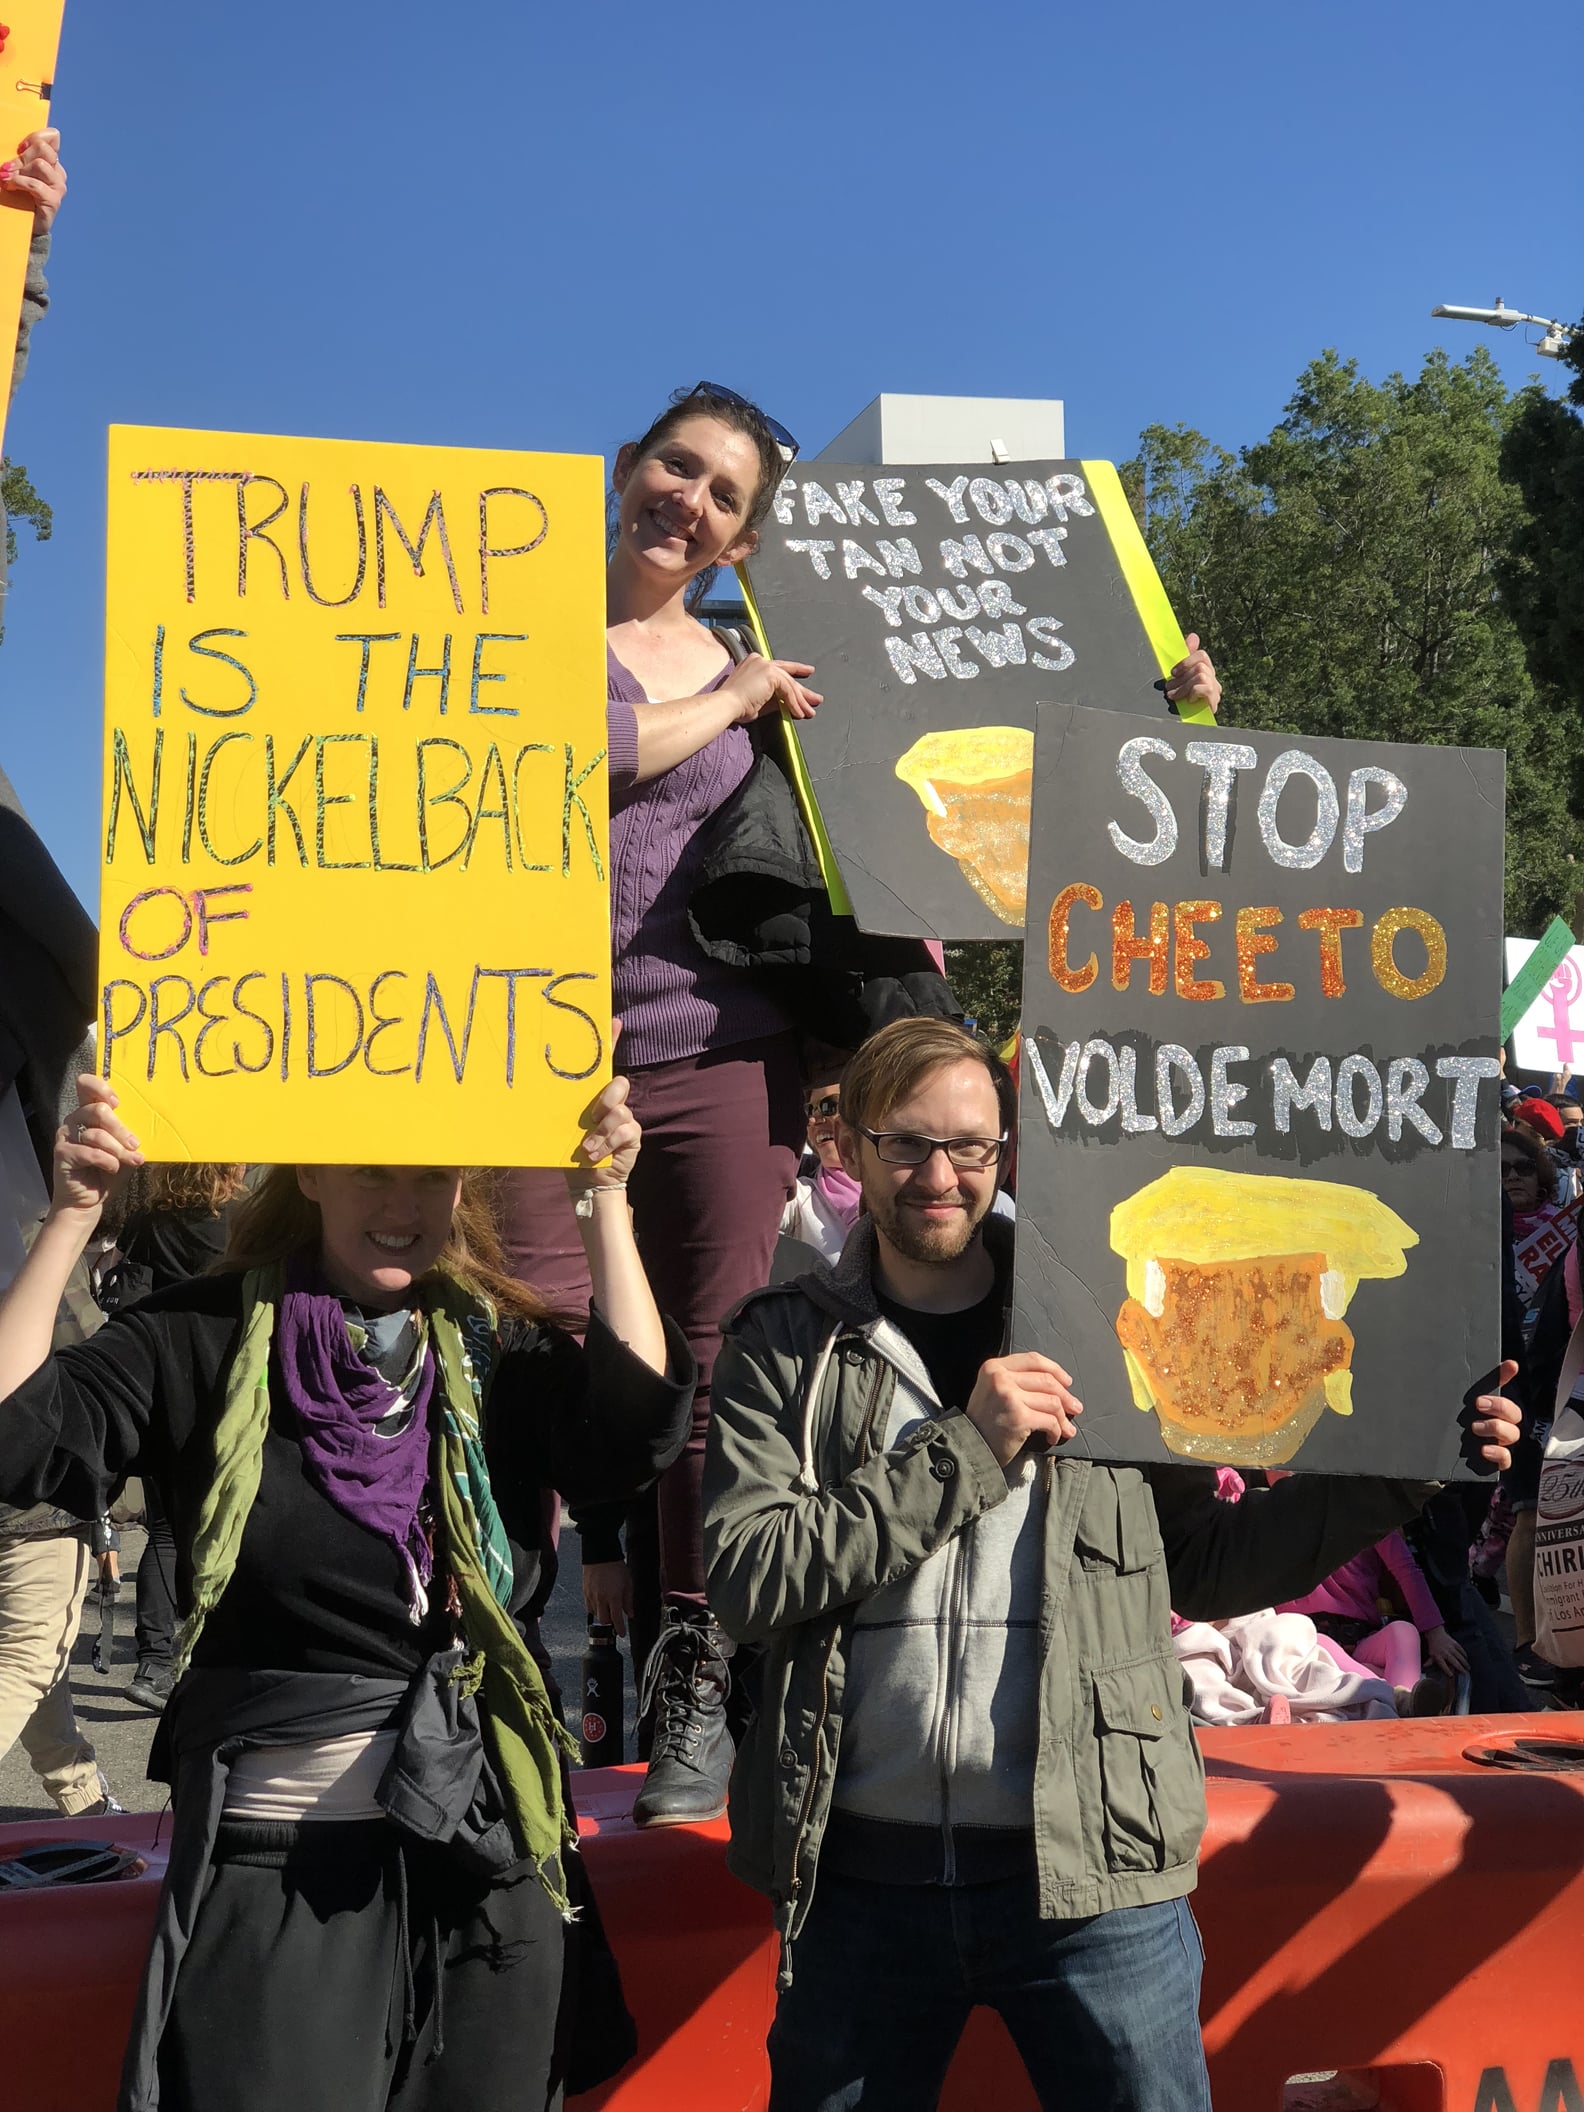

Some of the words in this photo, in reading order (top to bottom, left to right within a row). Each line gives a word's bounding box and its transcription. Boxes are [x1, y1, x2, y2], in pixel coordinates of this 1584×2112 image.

[130, 467, 548, 615] TRUMP
[772, 477, 918, 527] FAKE
[925, 473, 1096, 526] YOUR
[785, 537, 924, 580] TAN
[939, 526, 1068, 578] NOT
[861, 580, 1027, 627] YOUR
[884, 616, 1077, 685] NEWS
[152, 623, 259, 718] IS
[335, 632, 529, 716] THE
[105, 727, 607, 881] NICKELBACK
[1107, 736, 1408, 874] STOP
[119, 883, 254, 961] OF
[1048, 882, 1448, 1004] CHEETO
[101, 964, 603, 1088] PRESIDENTS
